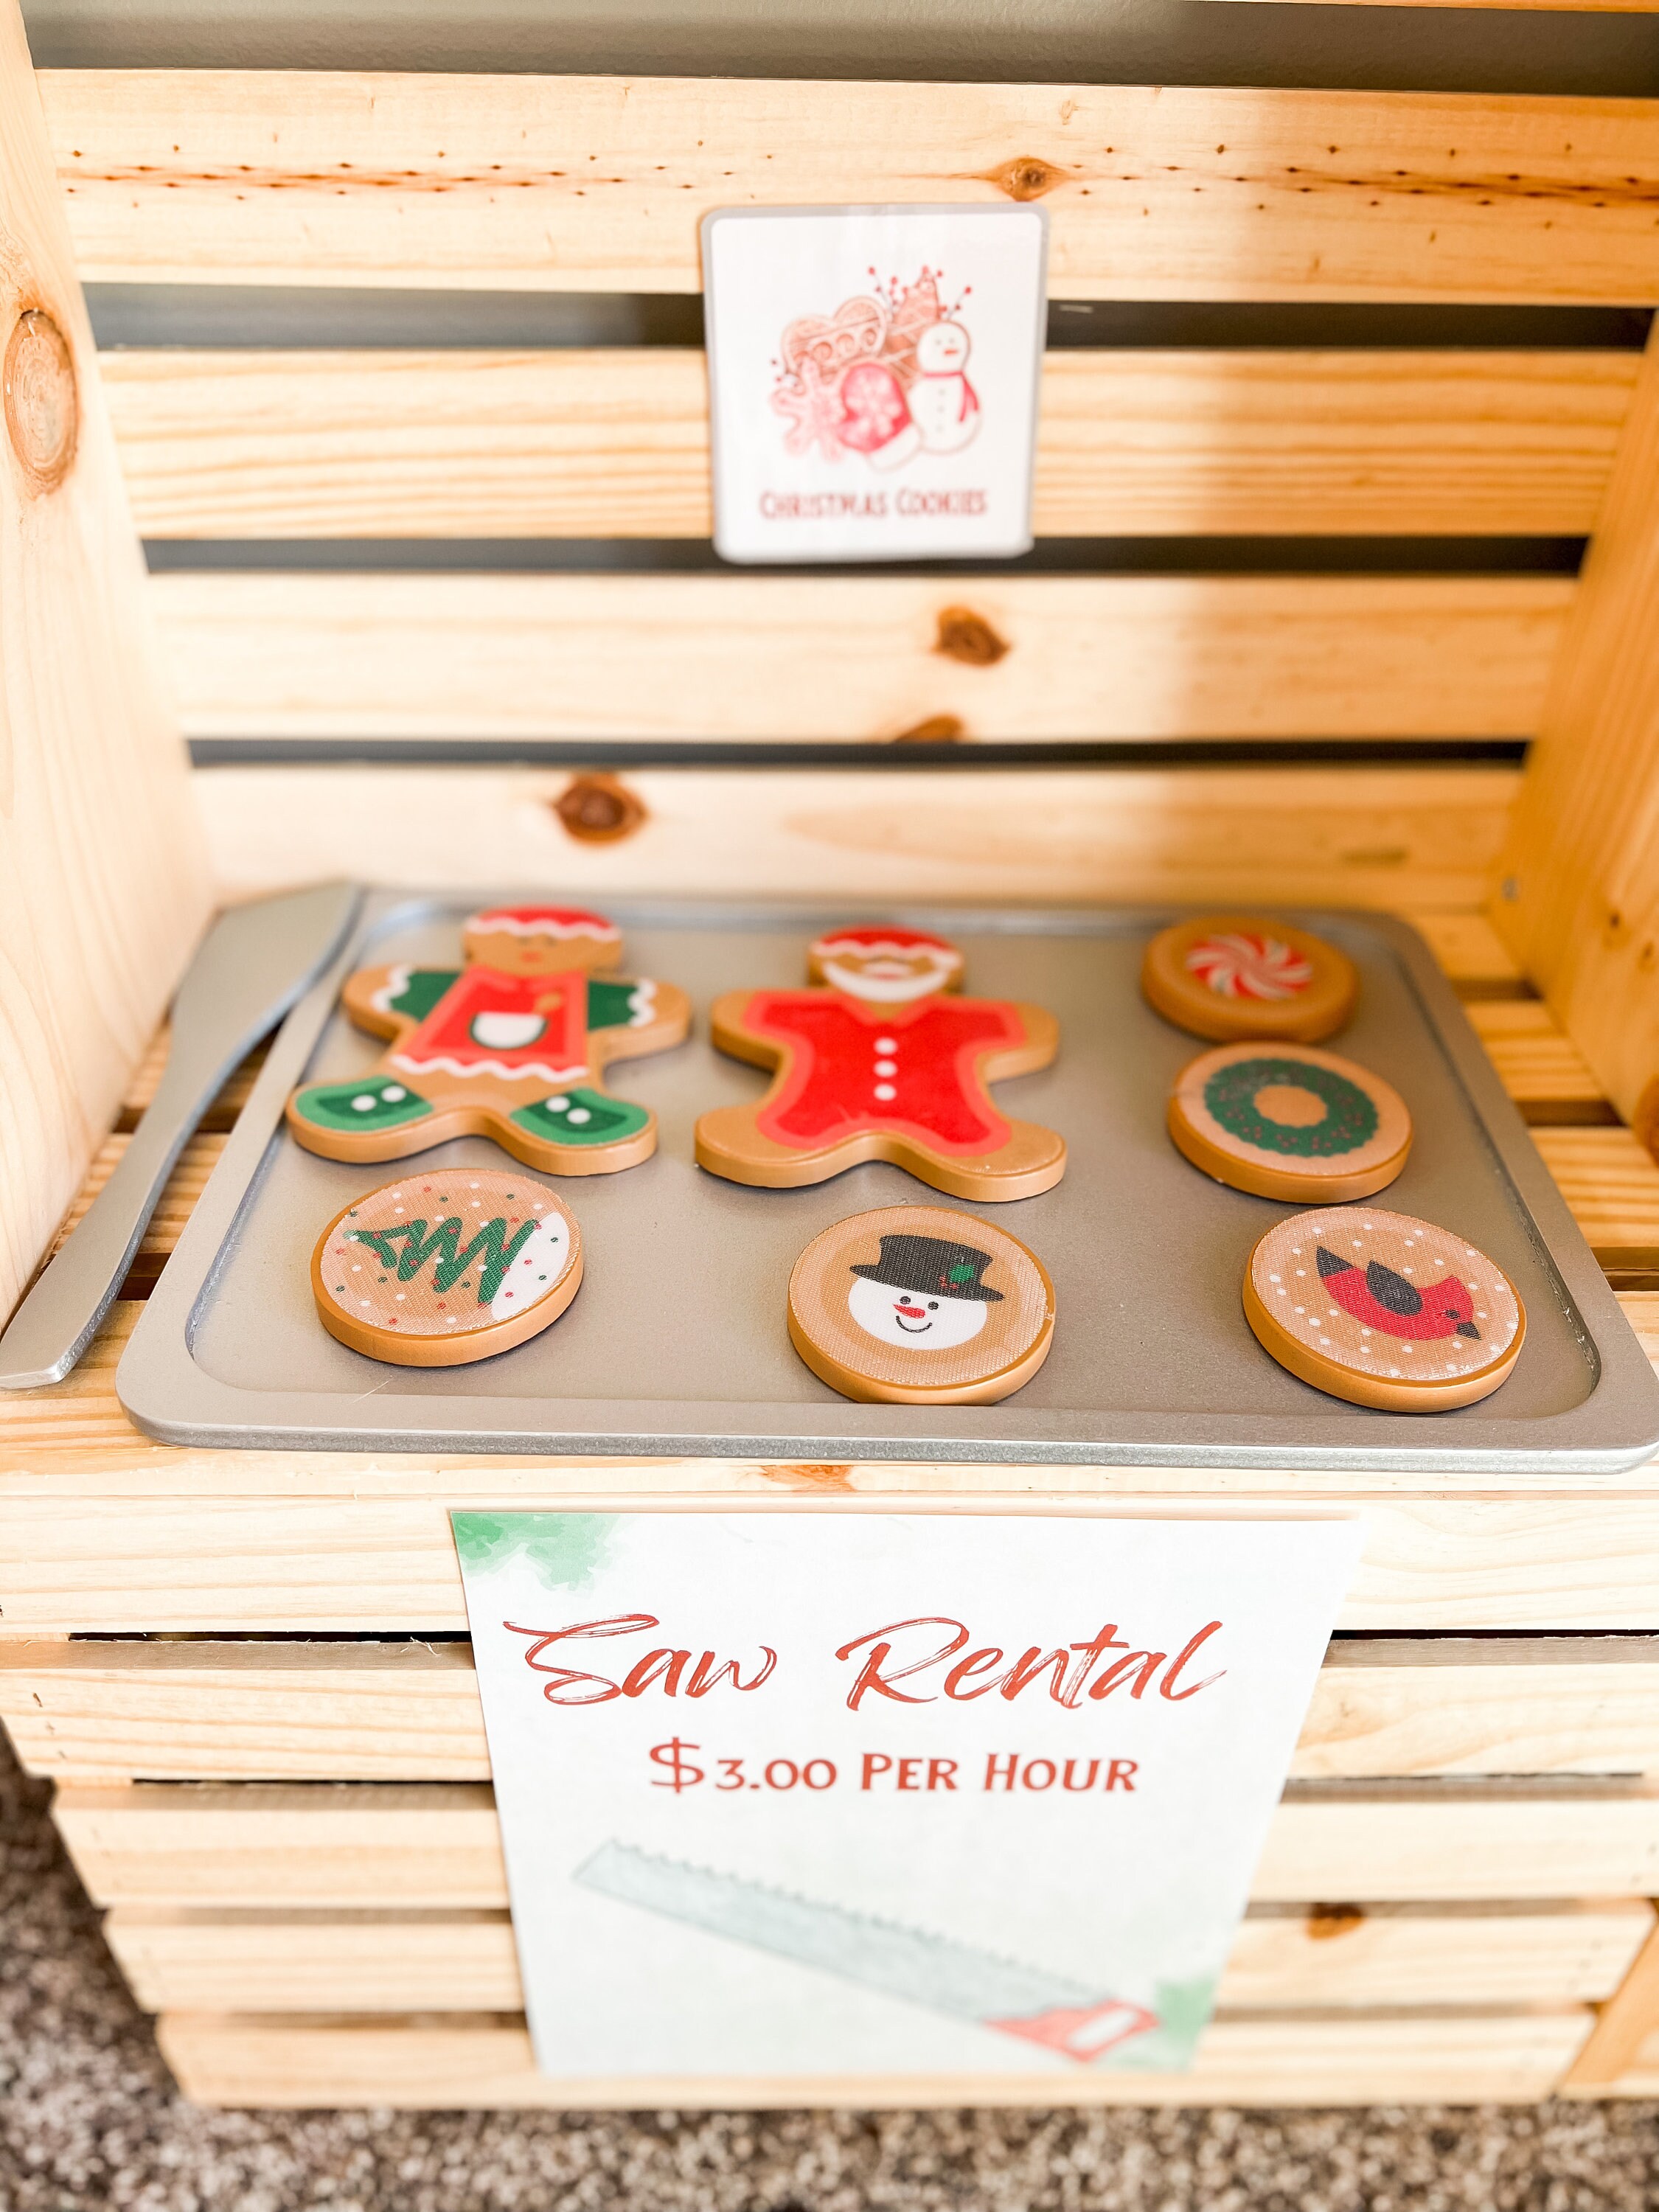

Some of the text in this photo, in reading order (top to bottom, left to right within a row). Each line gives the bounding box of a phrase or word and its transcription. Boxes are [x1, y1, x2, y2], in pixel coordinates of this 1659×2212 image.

[759, 488, 988, 519] CHRISTMAS COOKIES
[503, 1613, 1228, 1711] Saw Rental
[649, 1736, 1139, 1794] $3.00 PER HOUR
